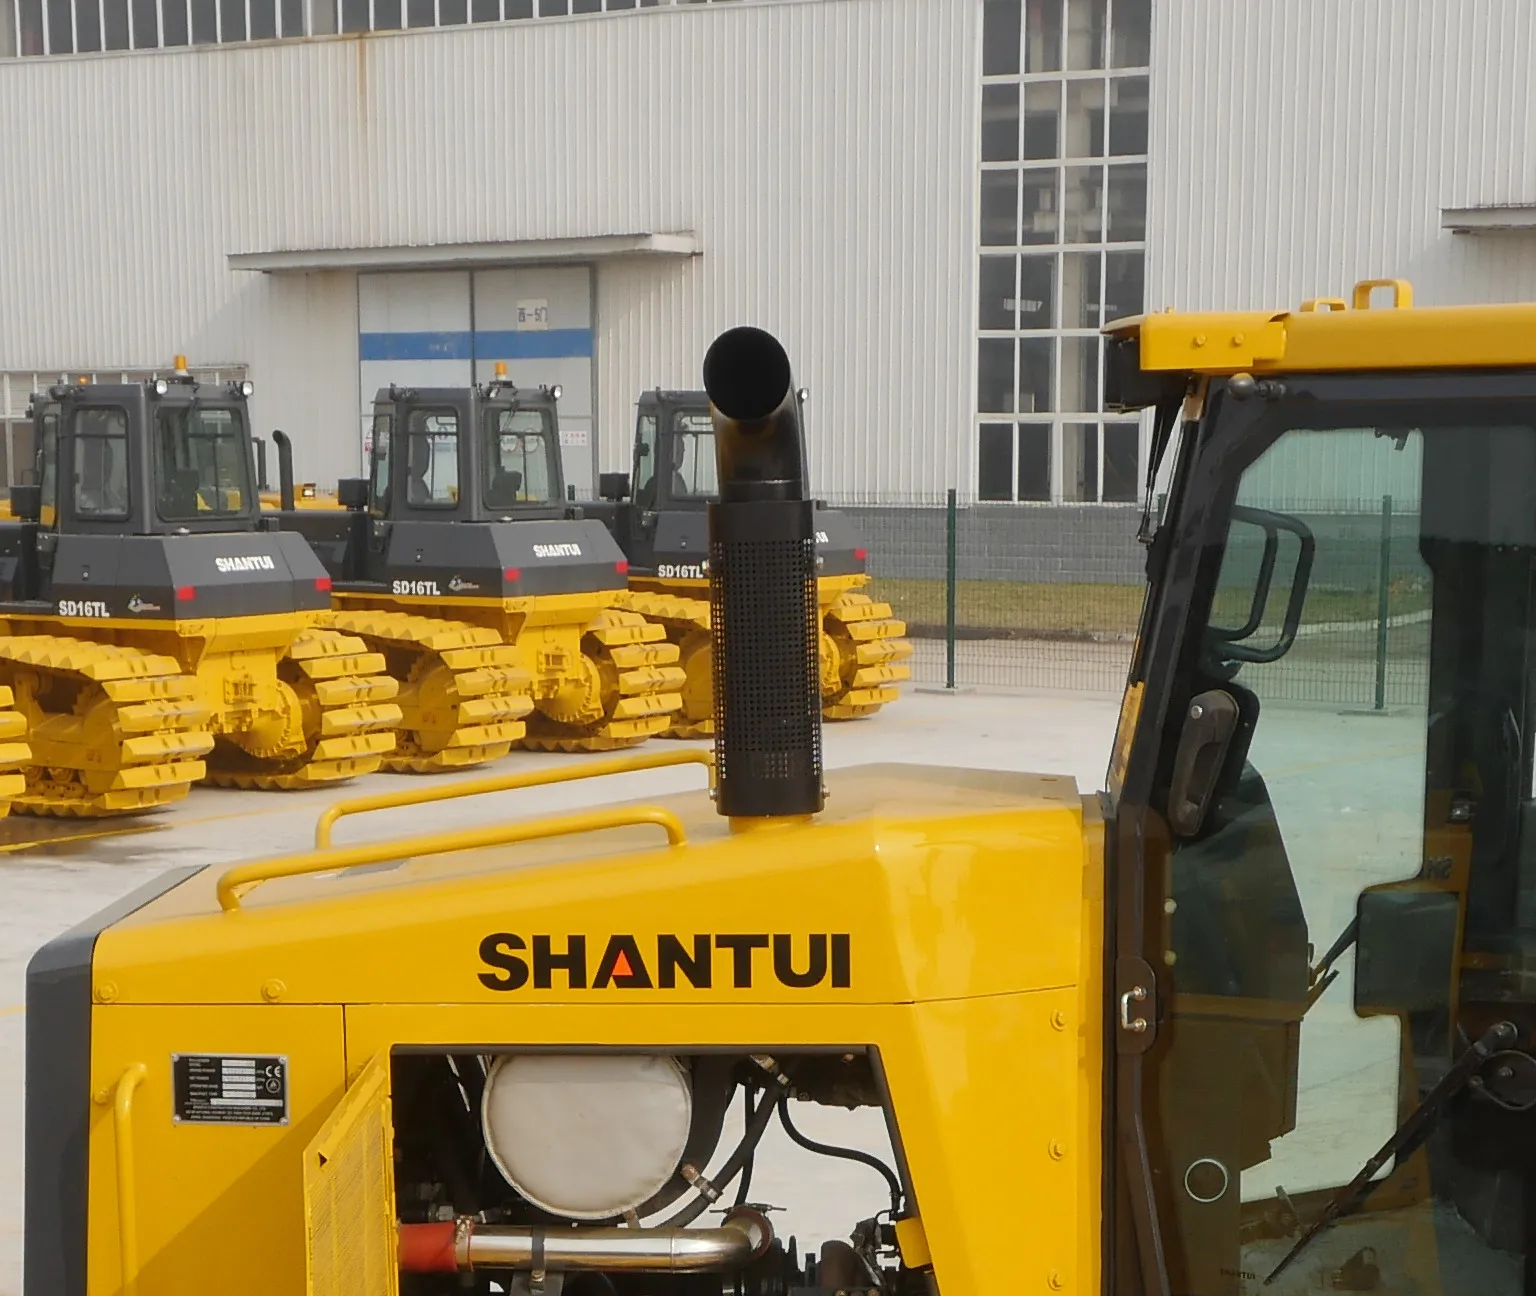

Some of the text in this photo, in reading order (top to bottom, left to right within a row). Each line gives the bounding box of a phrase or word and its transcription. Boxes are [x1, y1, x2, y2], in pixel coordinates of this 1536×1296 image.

[533, 543, 582, 558] SHANTUI
[215, 555, 275, 573] SHANTUI
[658, 564, 704, 578] SD16TL
[392, 580, 441, 596] SD16TL
[58, 600, 110, 617] SD16TL
[477, 932, 851, 991] SHANTUI
